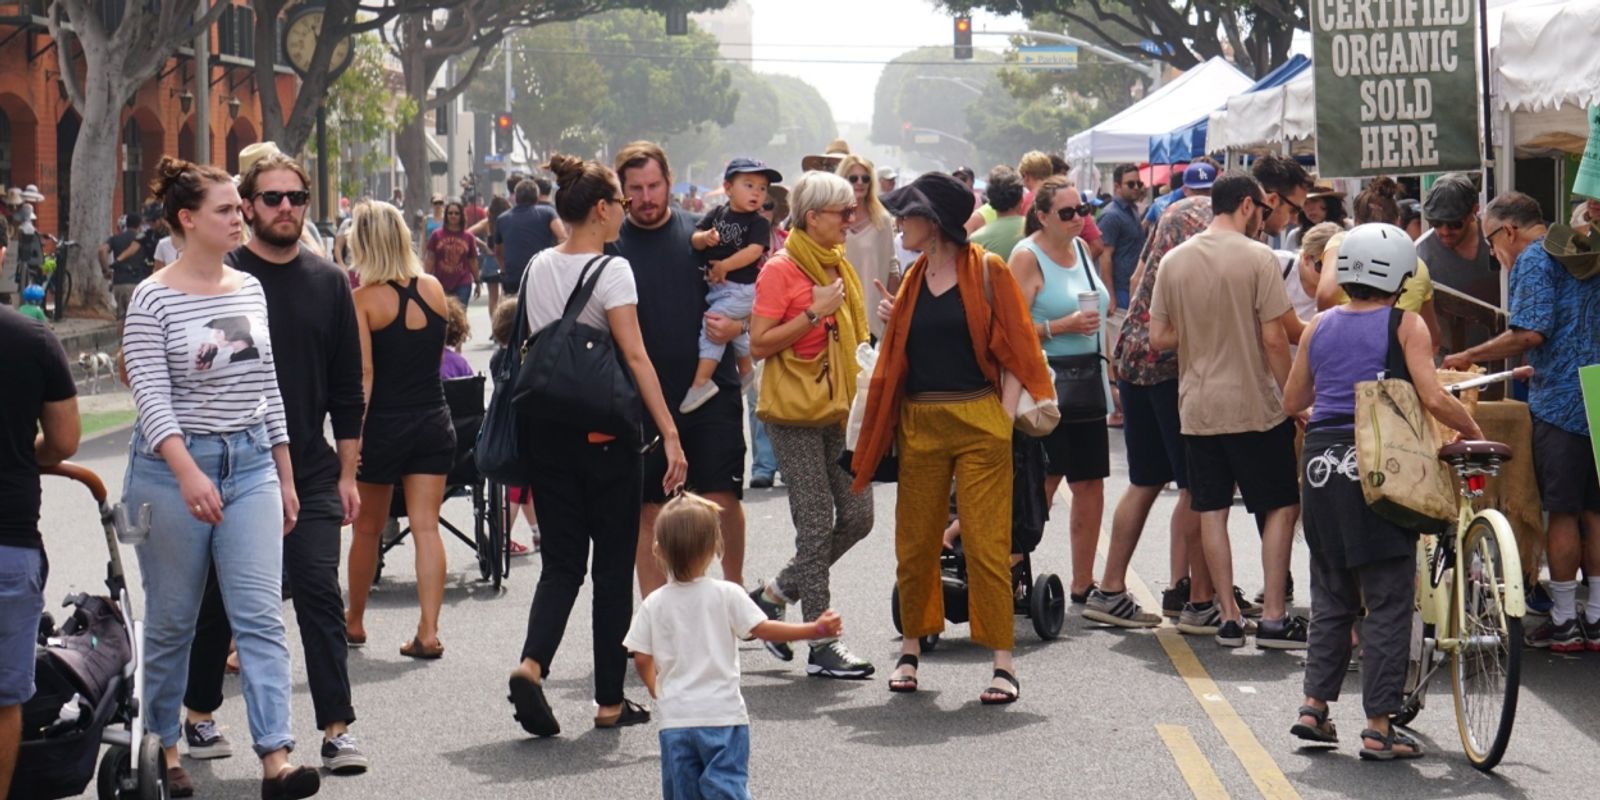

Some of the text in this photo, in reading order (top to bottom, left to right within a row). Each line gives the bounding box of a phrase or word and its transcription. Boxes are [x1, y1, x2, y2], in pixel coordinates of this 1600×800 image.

[1318, 0, 1470, 31] CERTIFIED
[1038, 56, 1073, 65] Parking
[1332, 30, 1458, 77] ORGANIC
[1360, 78, 1433, 122] SOLD
[1360, 123, 1439, 169] HERE
